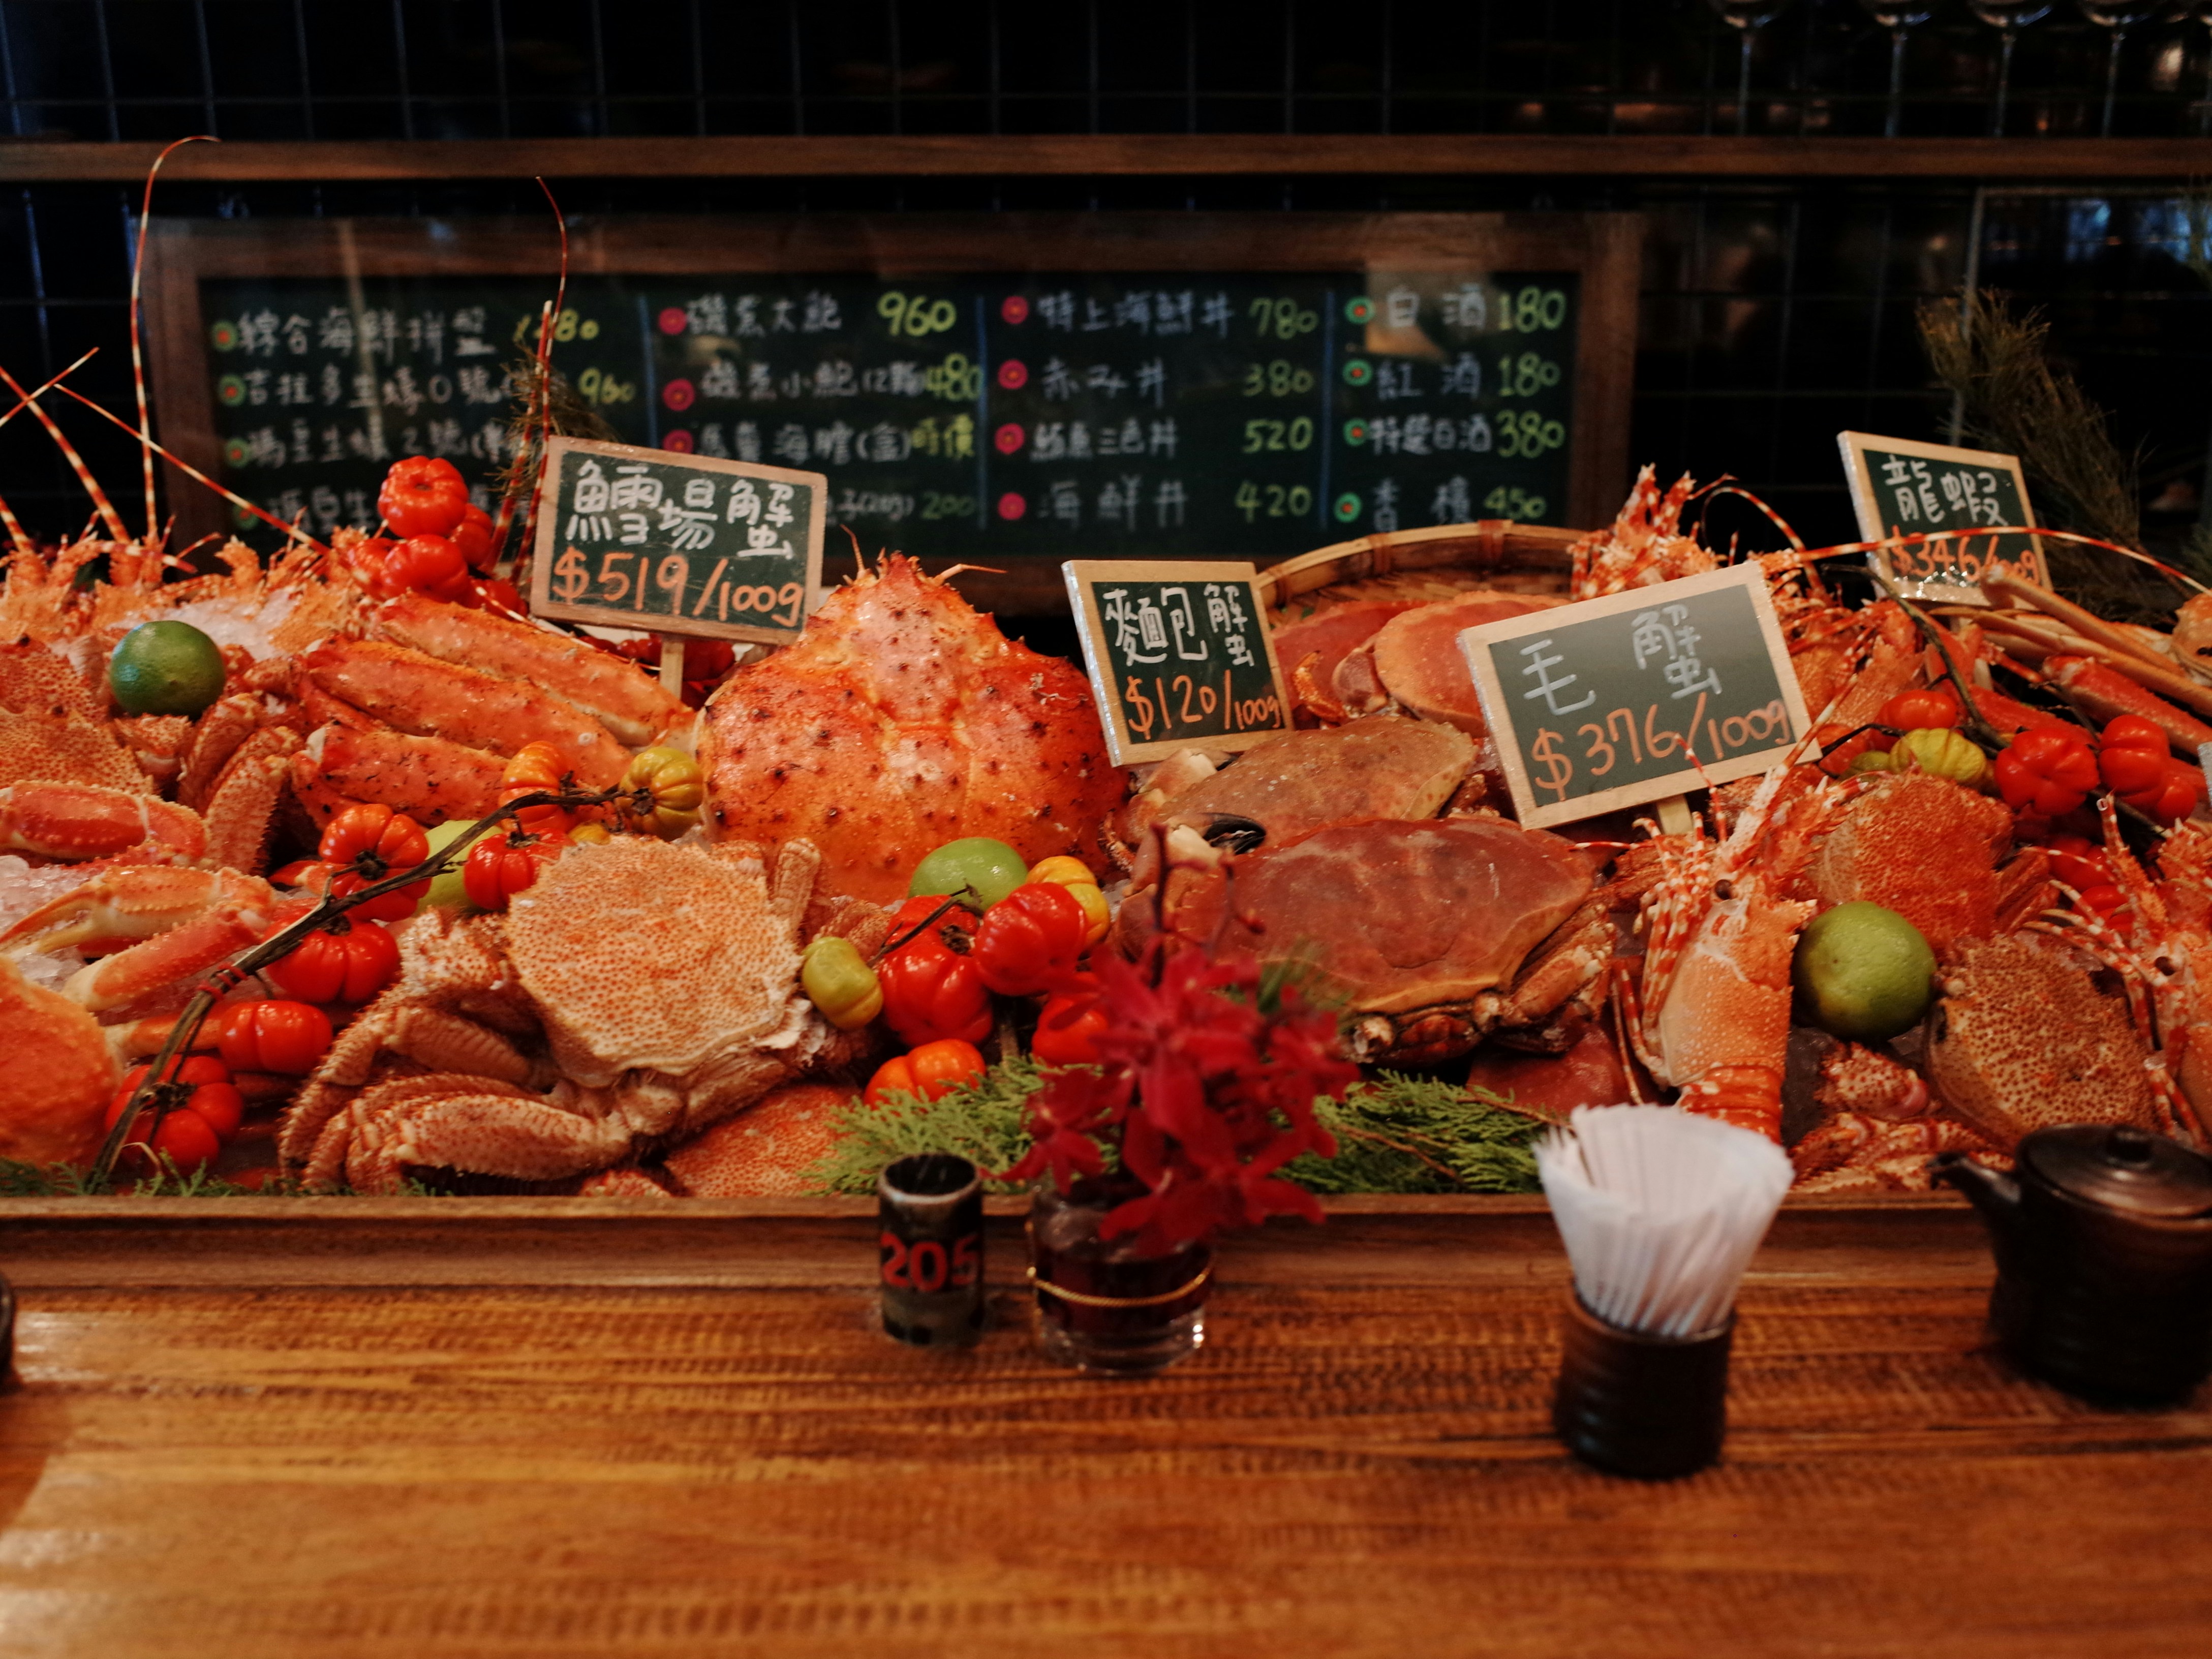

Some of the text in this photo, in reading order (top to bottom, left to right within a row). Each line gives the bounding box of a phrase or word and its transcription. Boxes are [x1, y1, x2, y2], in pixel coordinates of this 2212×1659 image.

[877, 291, 958, 337] 960
[1248, 296, 1319, 340] 780
[1386, 283, 1568, 333] 白酒 180
[578, 366, 637, 406] 960
[924, 353, 985, 402] 480
[1241, 359, 1315, 398] 380
[1375, 351, 1561, 402] 紅酒 180
[1243, 416, 1313, 453] 520
[1495, 409, 1565, 458] 380
[564, 458, 797, 560] 鱈場蟹
[920, 491, 976, 520] 200
[1235, 480, 1312, 524] 420
[1483, 486, 1547, 519] 450
[1882, 454, 2009, 527] 龍蝦
[551, 545, 805, 628] $519/100g
[1102, 582, 1255, 667] 麵包蟹
[1519, 603, 1723, 716] 毛蟹
[1125, 668, 1281, 740] $120/100g
[1531, 691, 1790, 802] $376/100g
